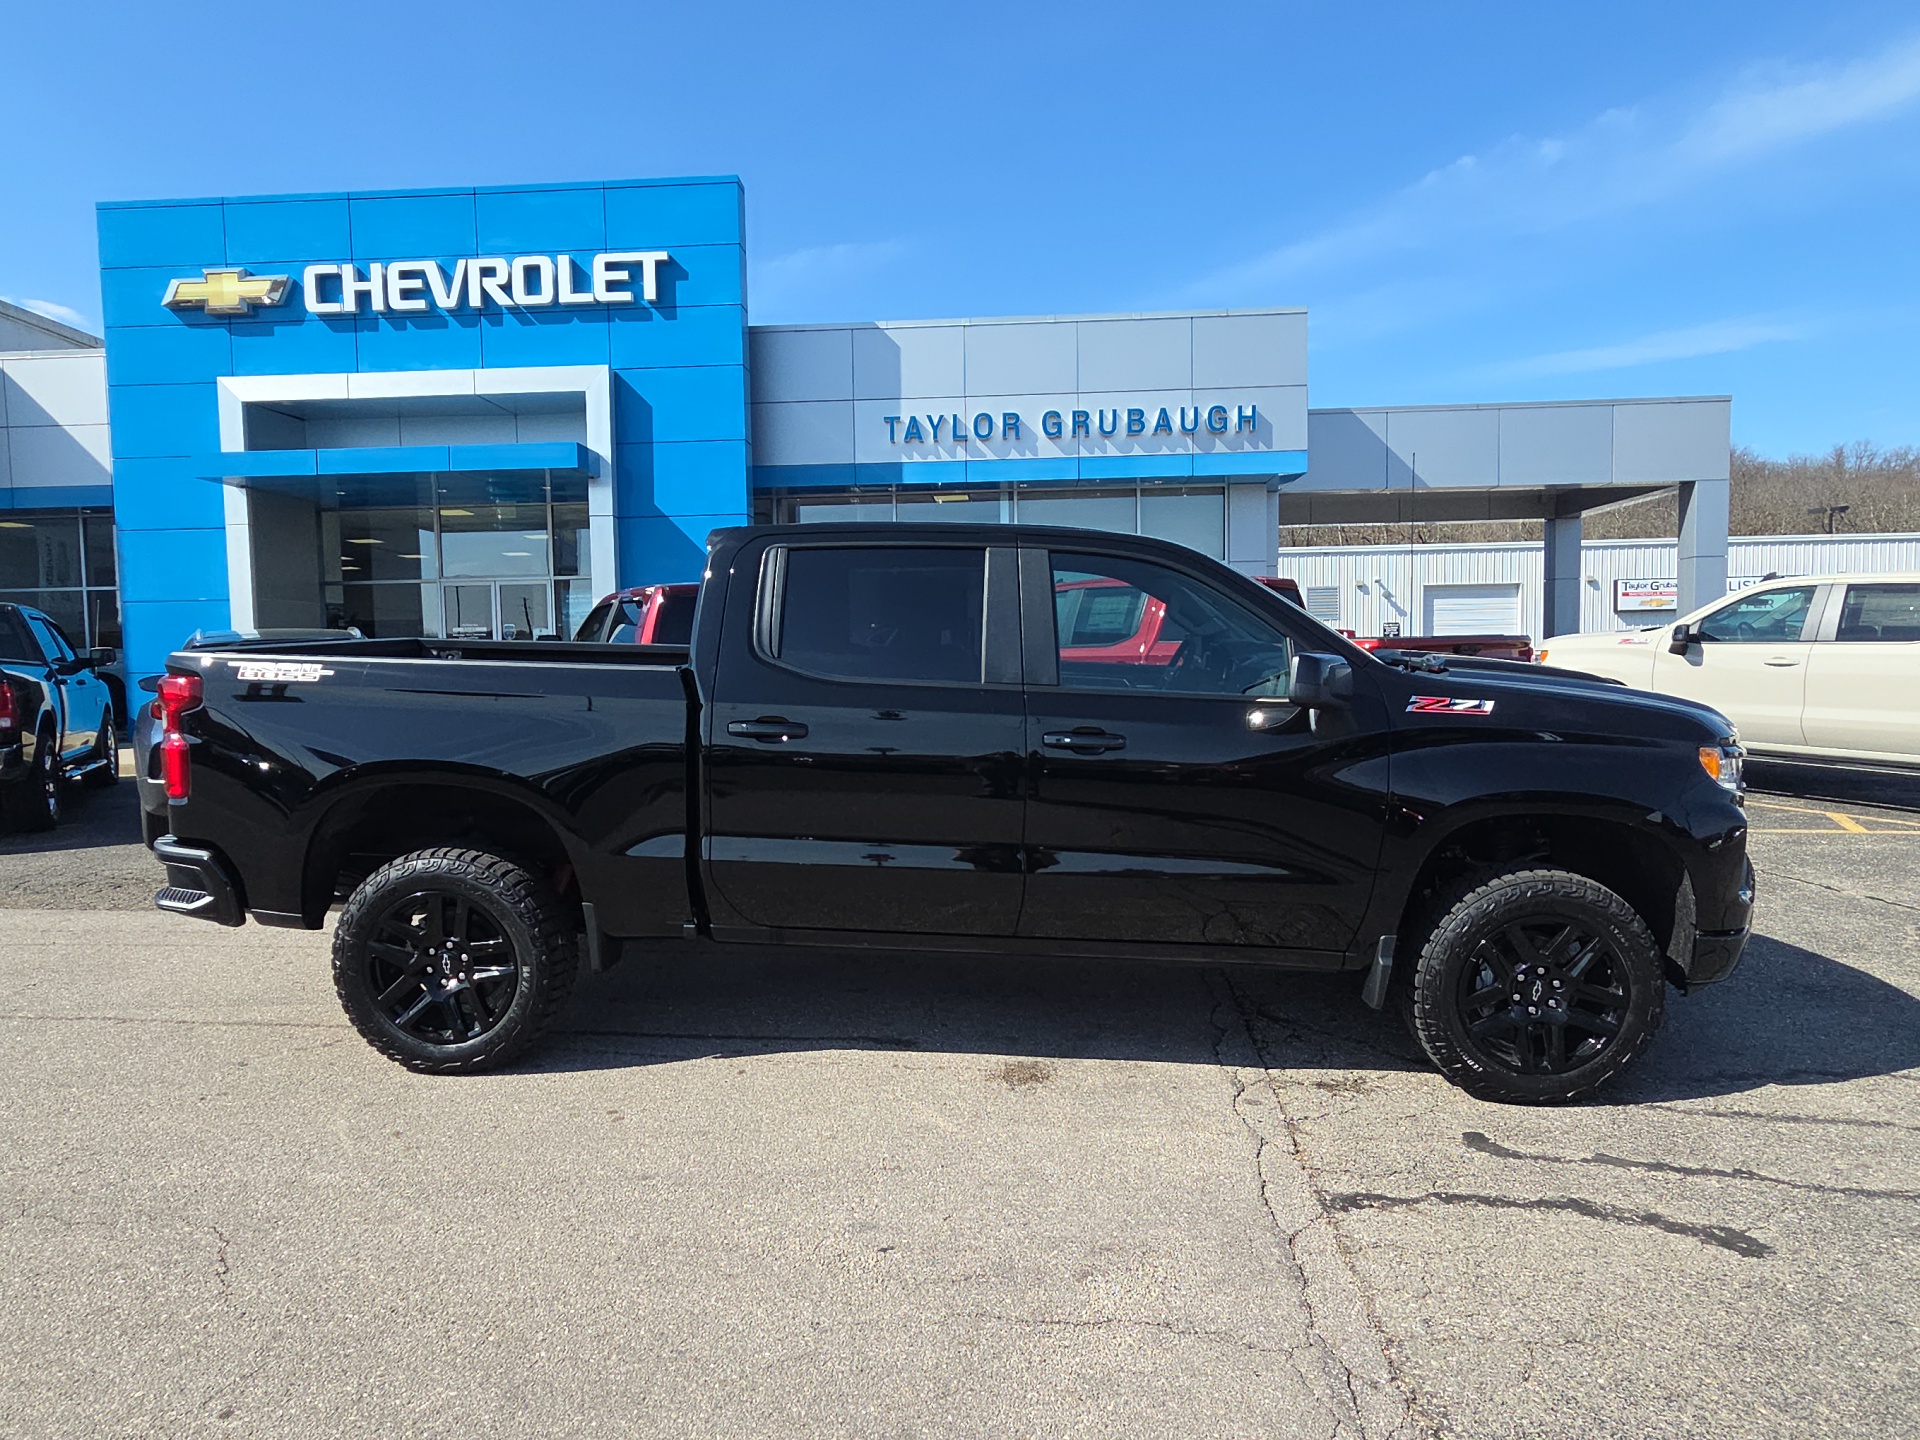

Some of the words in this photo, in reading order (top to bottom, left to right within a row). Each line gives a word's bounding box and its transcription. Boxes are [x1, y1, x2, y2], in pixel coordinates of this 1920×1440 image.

[303, 251, 669, 314] CHEVROLET
[883, 412, 1021, 443] TAYLOR
[1041, 404, 1258, 438] GRUBAUGH
[1621, 581, 1649, 591] Taylor
[1650, 581, 1678, 591] Gruba
[228, 661, 334, 674] TRAIL
[237, 671, 321, 681] BOSS
[1405, 695, 1495, 715] Z71
